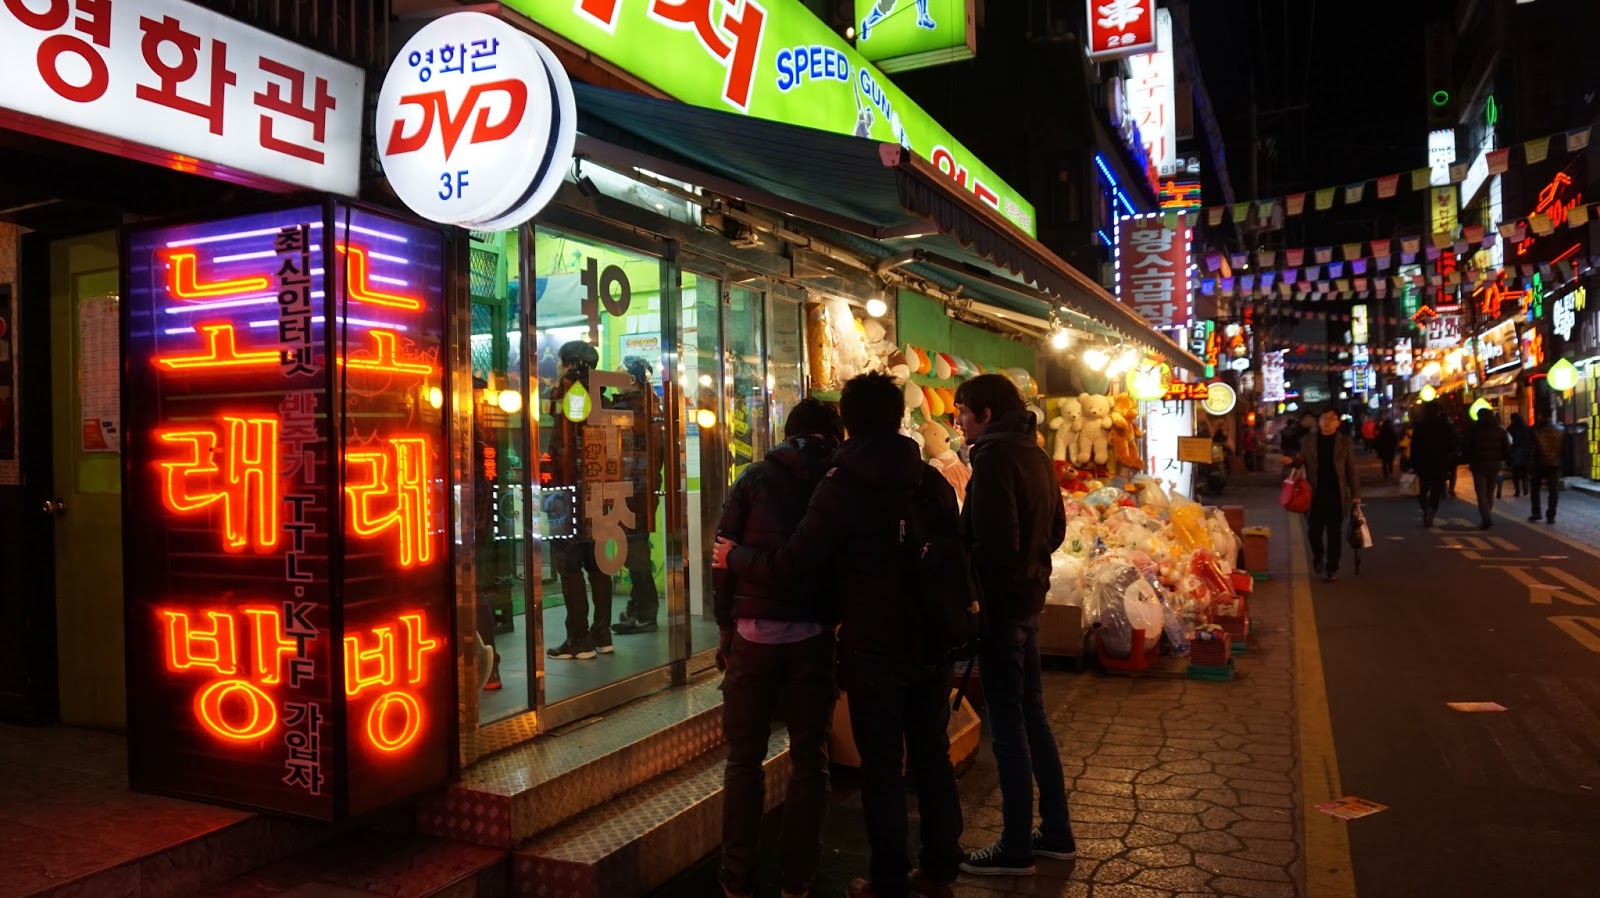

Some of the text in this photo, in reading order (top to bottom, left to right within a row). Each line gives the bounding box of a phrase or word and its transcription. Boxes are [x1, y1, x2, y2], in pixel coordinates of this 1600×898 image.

[4, 0, 337, 165] 영화관
[408, 37, 500, 83] 영화관
[776, 46, 849, 91] SPEED
[860, 67, 892, 120] GUN
[385, 78, 528, 163] DVD
[438, 170, 470, 201] 3F
[277, 223, 316, 377] 최신인터넷
[157, 245, 299, 741] 노래방
[337, 243, 437, 751] 노래방
[282, 702, 324, 796] 가입자
